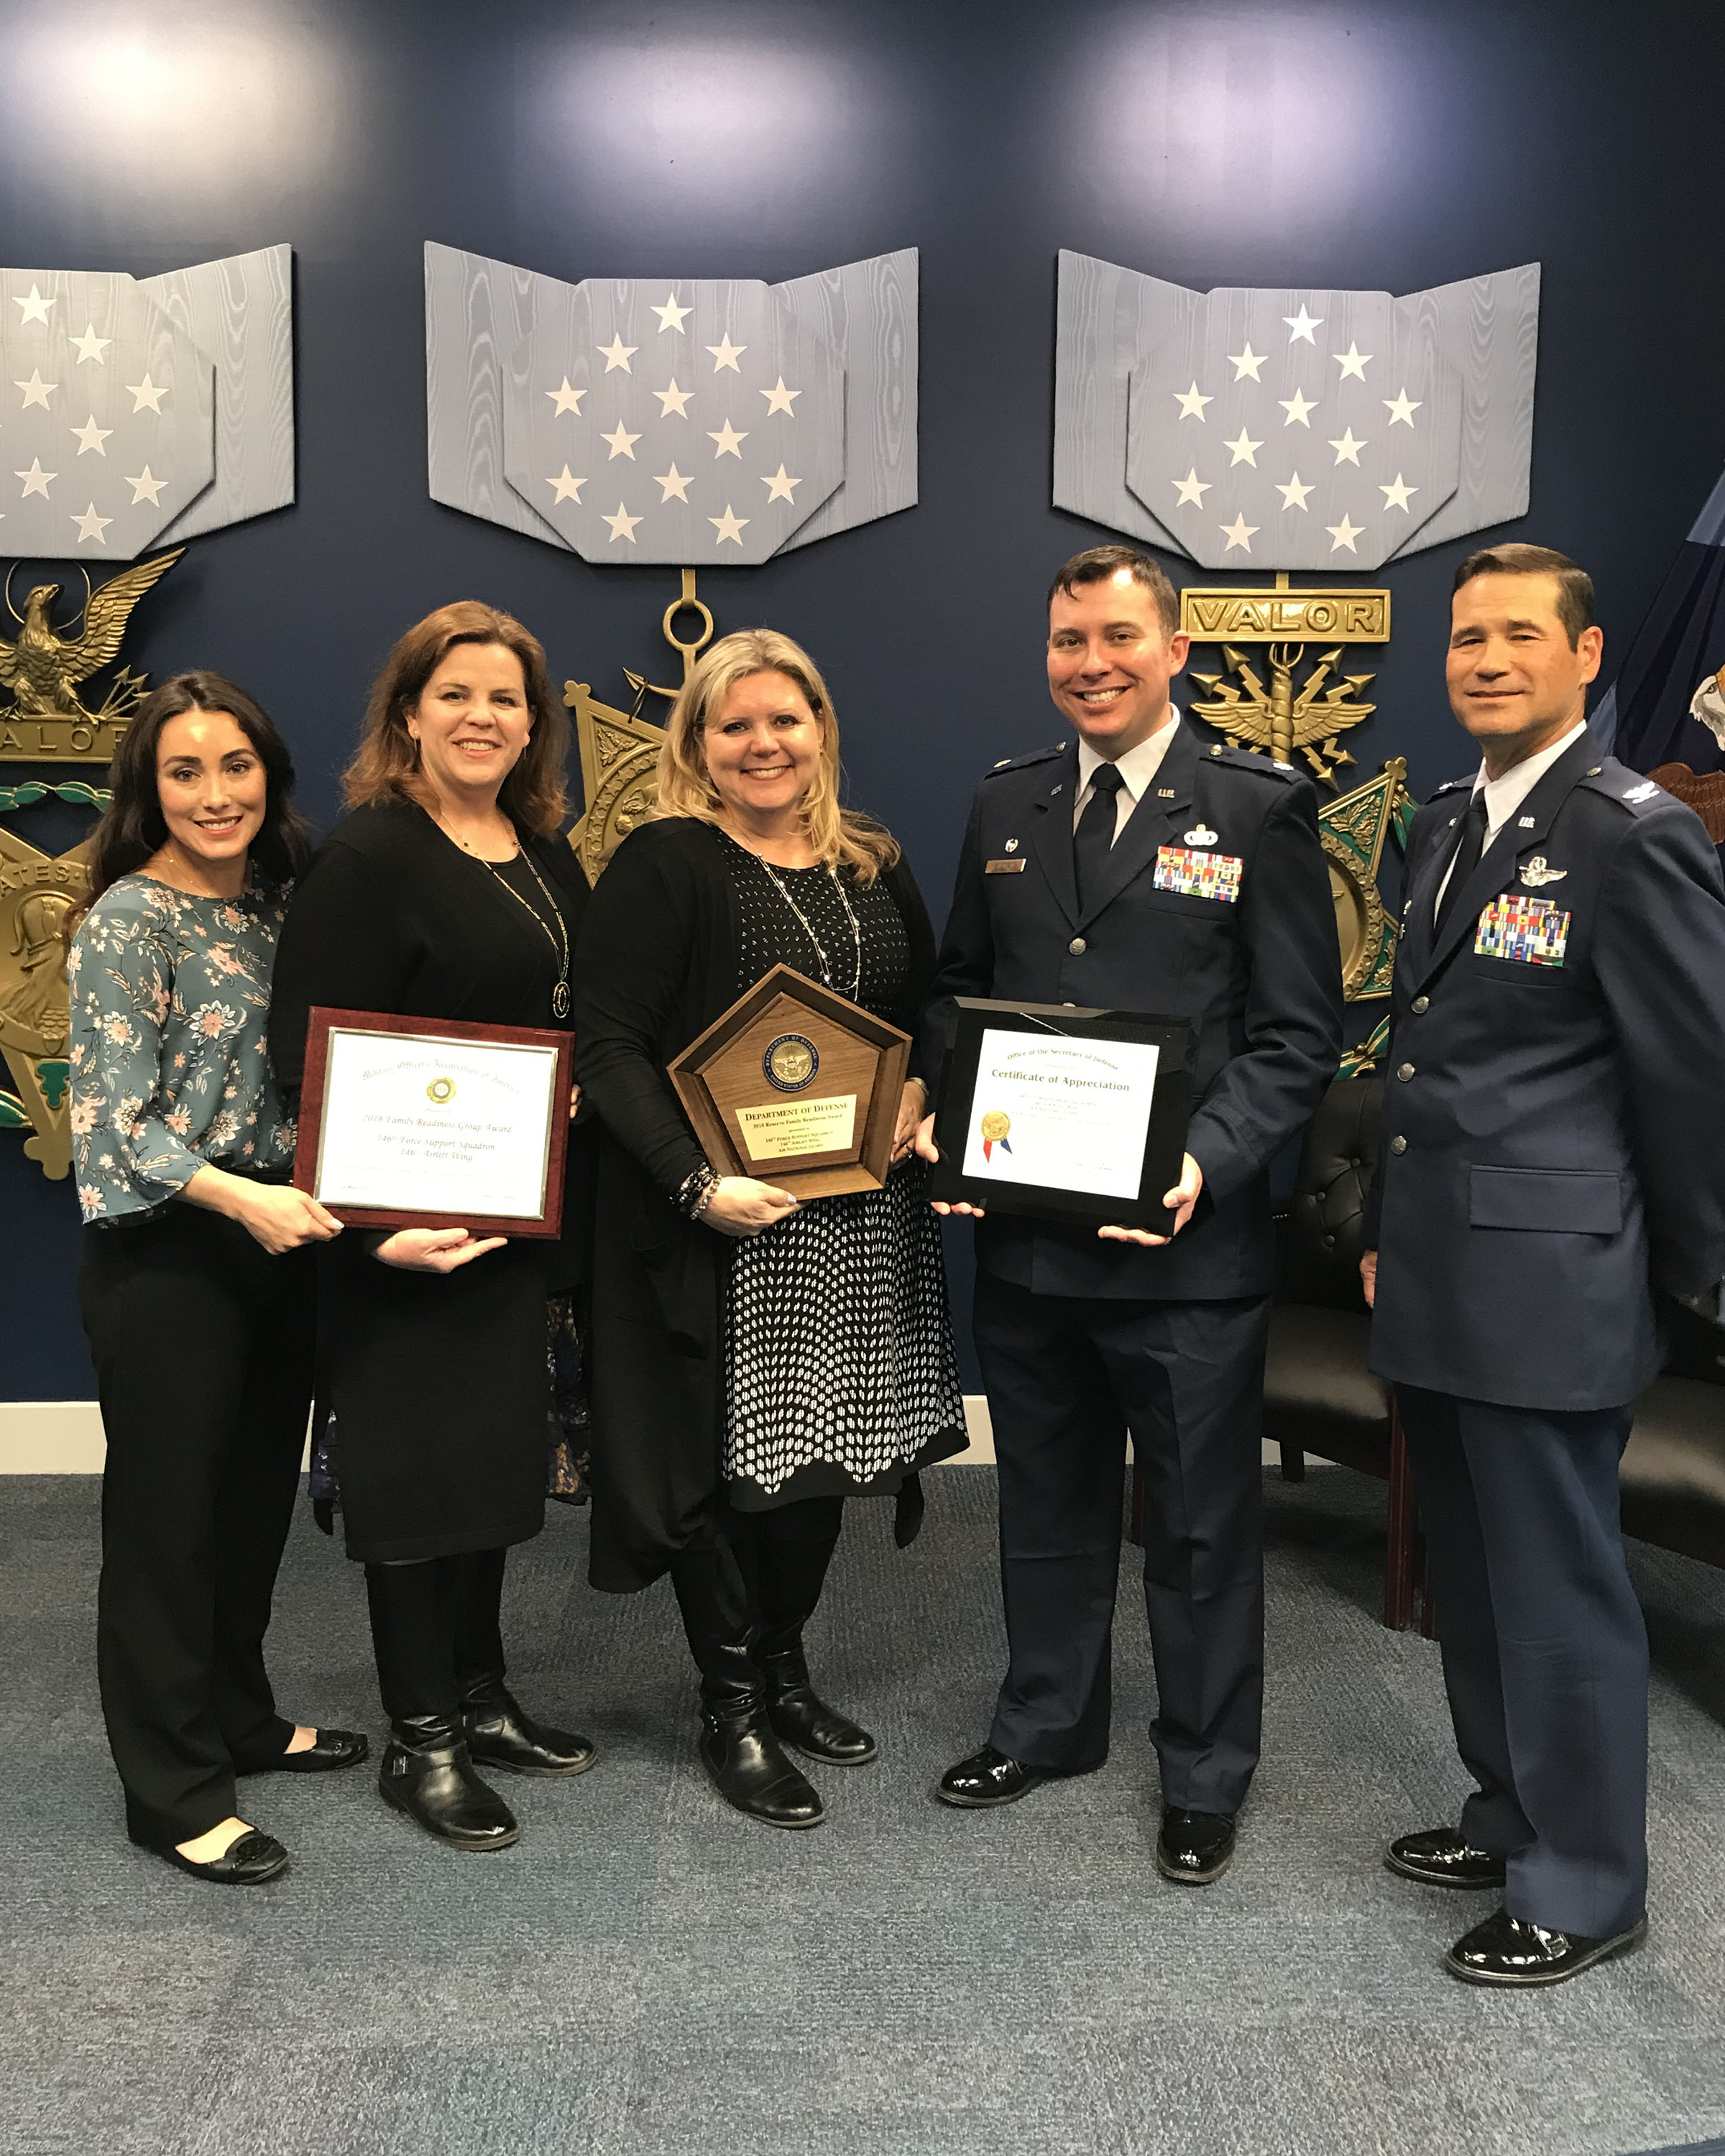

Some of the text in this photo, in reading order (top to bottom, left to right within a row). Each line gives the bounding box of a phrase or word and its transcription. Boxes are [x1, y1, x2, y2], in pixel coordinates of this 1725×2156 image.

[1192, 602, 1376, 632] VALOR
[1007, 1051, 1026, 1060] Office
[1051, 1049, 1082, 1058] Secretary
[1093, 1056, 1119, 1070] Defense
[991, 1069, 1130, 1092] Certificate of Appreciation
[745, 1109, 799, 1121] DEPARTMENT
[814, 1102, 848, 1113] DEFENSE
[362, 1114, 513, 1133] 2018 Family Readiness Group Award
[426, 1138, 456, 1149] Support
[457, 1141, 495, 1151] Squadron
